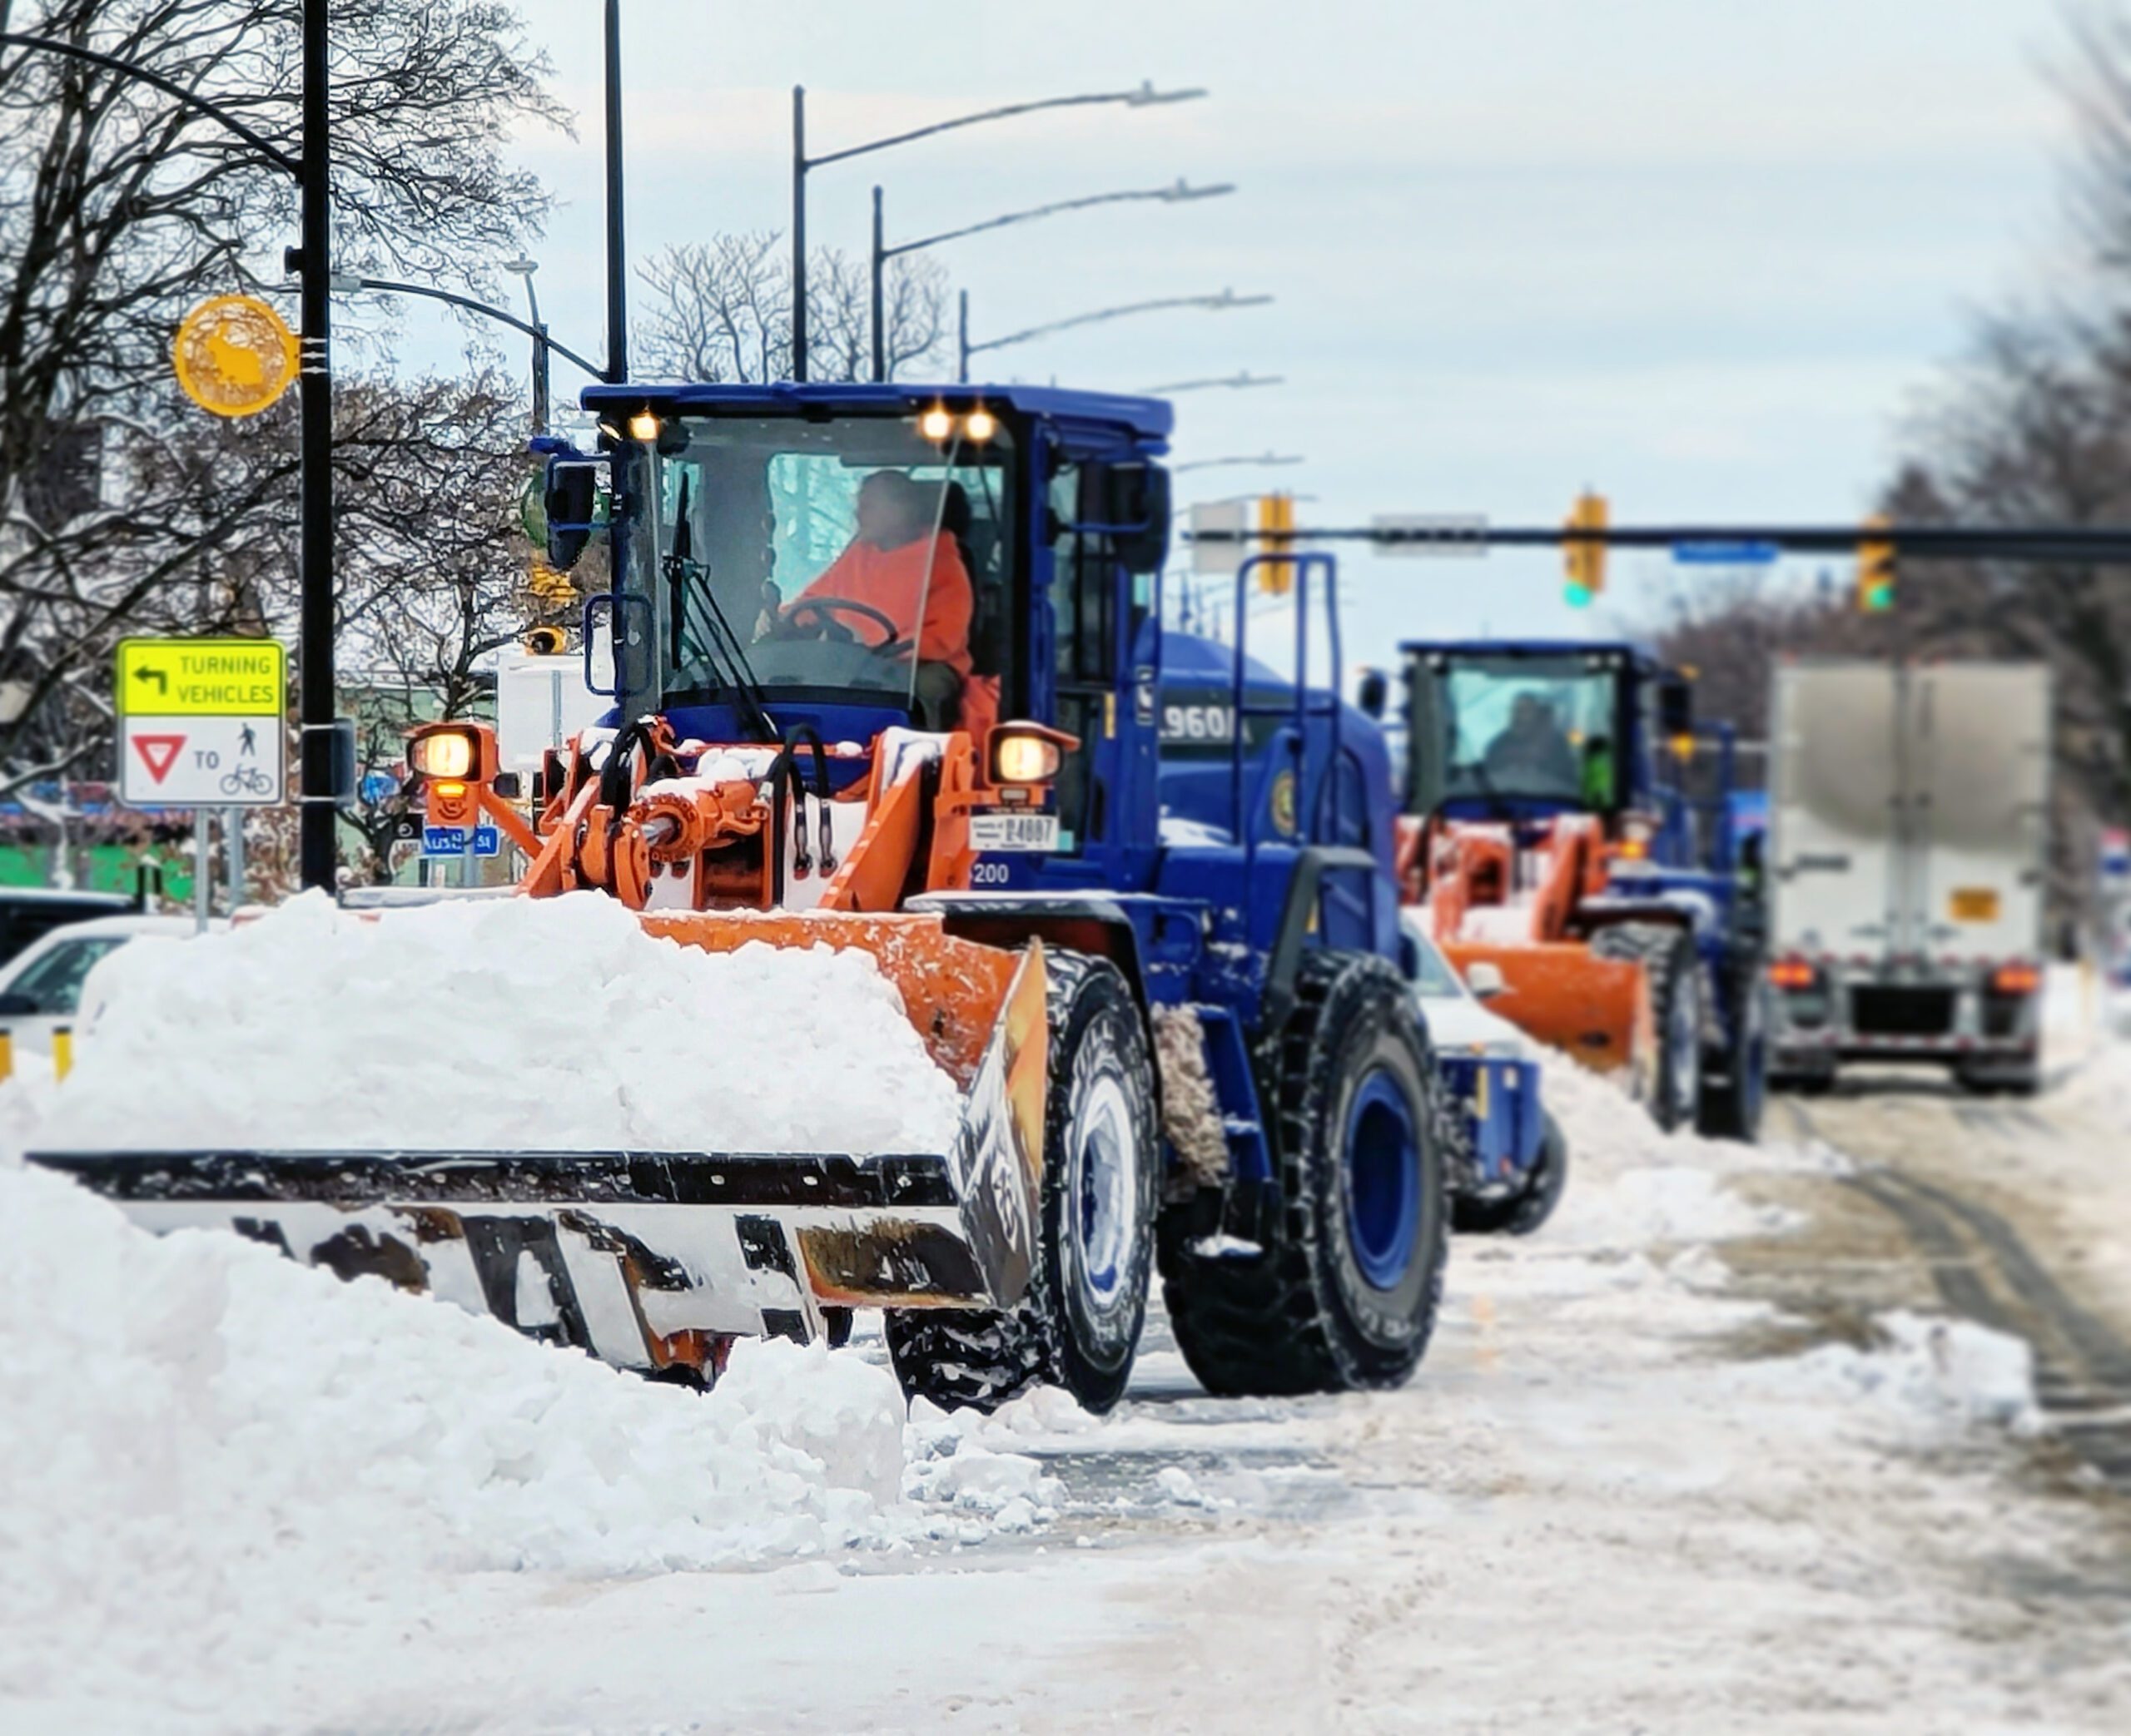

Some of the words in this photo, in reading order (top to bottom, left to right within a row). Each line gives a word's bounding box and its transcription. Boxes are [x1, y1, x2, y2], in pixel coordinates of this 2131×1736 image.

[181, 656, 271, 675] TURNING
[178, 686, 274, 703] VEHICLES
[194, 751, 220, 769] TO
[973, 863, 1009, 883] 200
